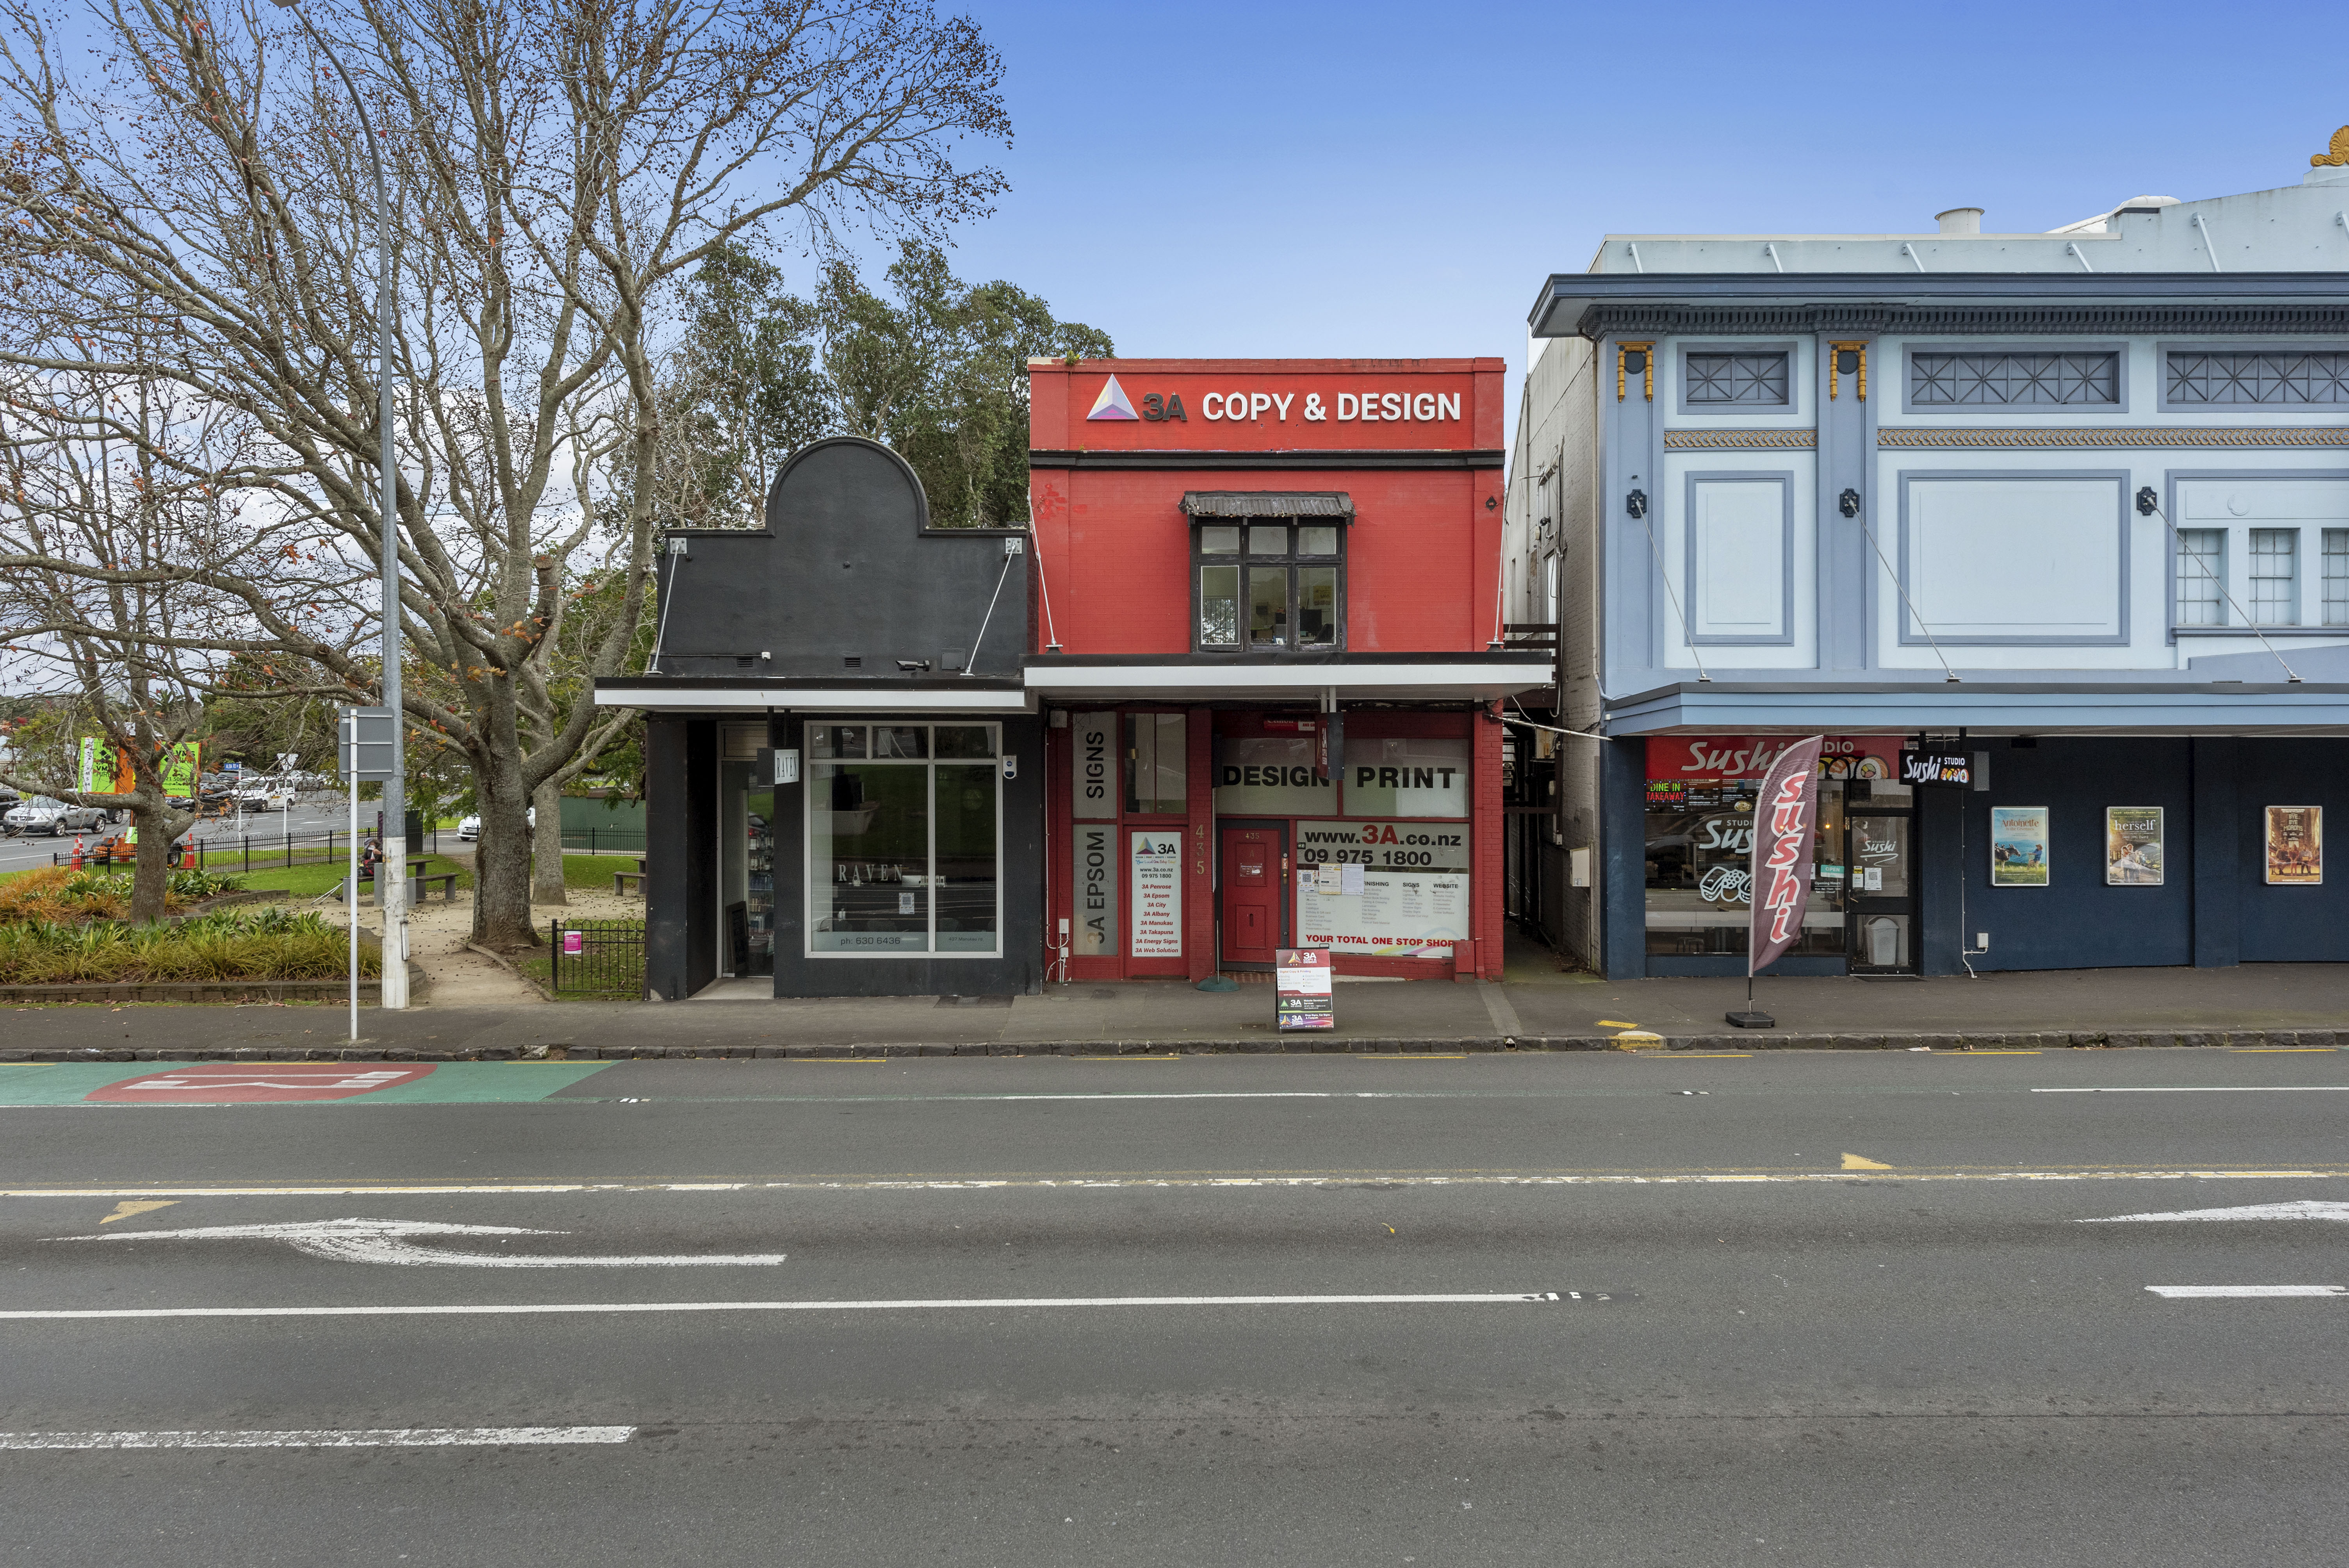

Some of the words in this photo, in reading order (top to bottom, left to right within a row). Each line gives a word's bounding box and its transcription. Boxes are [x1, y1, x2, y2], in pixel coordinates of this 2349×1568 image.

[1142, 392, 1188, 421] 3A
[1203, 392, 1295, 421] COPY
[1303, 392, 1327, 421] &
[1338, 392, 1460, 421] DESIGN
[777, 757, 797, 778] RAVEN
[1086, 732, 1104, 799] SIGNS
[1681, 742, 1784, 775] Sushi
[1903, 755, 1941, 783] Sushi
[1944, 757, 1965, 766] STUDIO
[1357, 766, 1456, 788] PRINT
[1650, 783, 1669, 792] DINE
[1672, 783, 1680, 792] IN
[1646, 792, 1685, 800] TAKEAWAY
[2001, 818, 2039, 827] Antoinette
[2114, 819, 2156, 830] herself
[1305, 824, 1461, 846] www.3A.co.nz
[1699, 820, 1754, 853] Sus
[1158, 844, 1176, 854] 3A
[1304, 848, 1328, 863] 09
[1336, 850, 1374, 864] 975
[1383, 850, 1432, 866] 1800
[1764, 770, 1810, 944] sushi
[1862, 840, 1896, 853] Sushi
[838, 864, 903, 882] RAVEN
[1087, 832, 1105, 909] EPSOM
[1087, 916, 1105, 944] 3A
[841, 937, 853, 946] ph:
[1306, 934, 1333, 943] YOUR
[1337, 935, 1368, 944] TOTAL
[1372, 937, 1393, 945] ONE
[1396, 937, 1423, 946] STOP
[1426, 939, 1453, 948] SHOP
